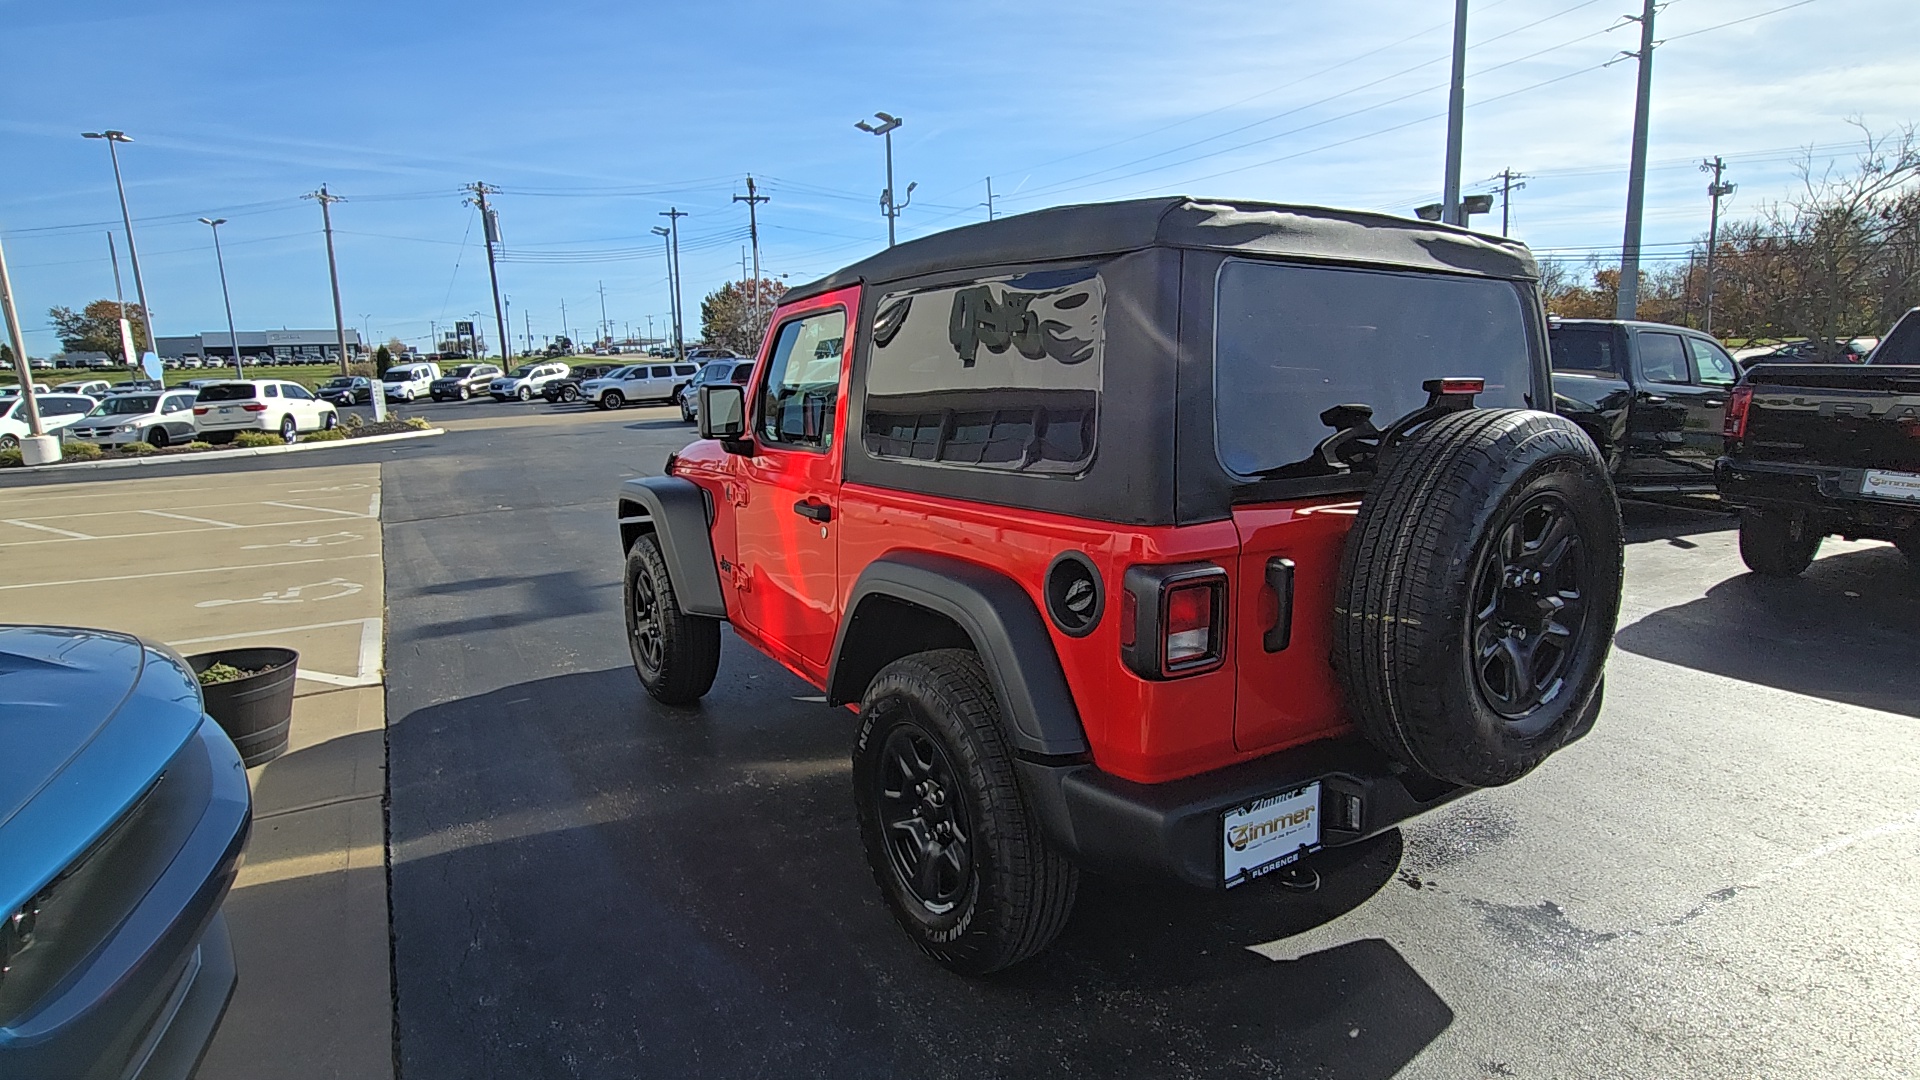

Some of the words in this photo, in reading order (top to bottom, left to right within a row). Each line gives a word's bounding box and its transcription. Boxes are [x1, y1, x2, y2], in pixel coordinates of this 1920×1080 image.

[1250, 788, 1299, 812] Zimmer
[1230, 804, 1316, 847] Zimmer
[1252, 853, 1299, 879] FLORENCE
